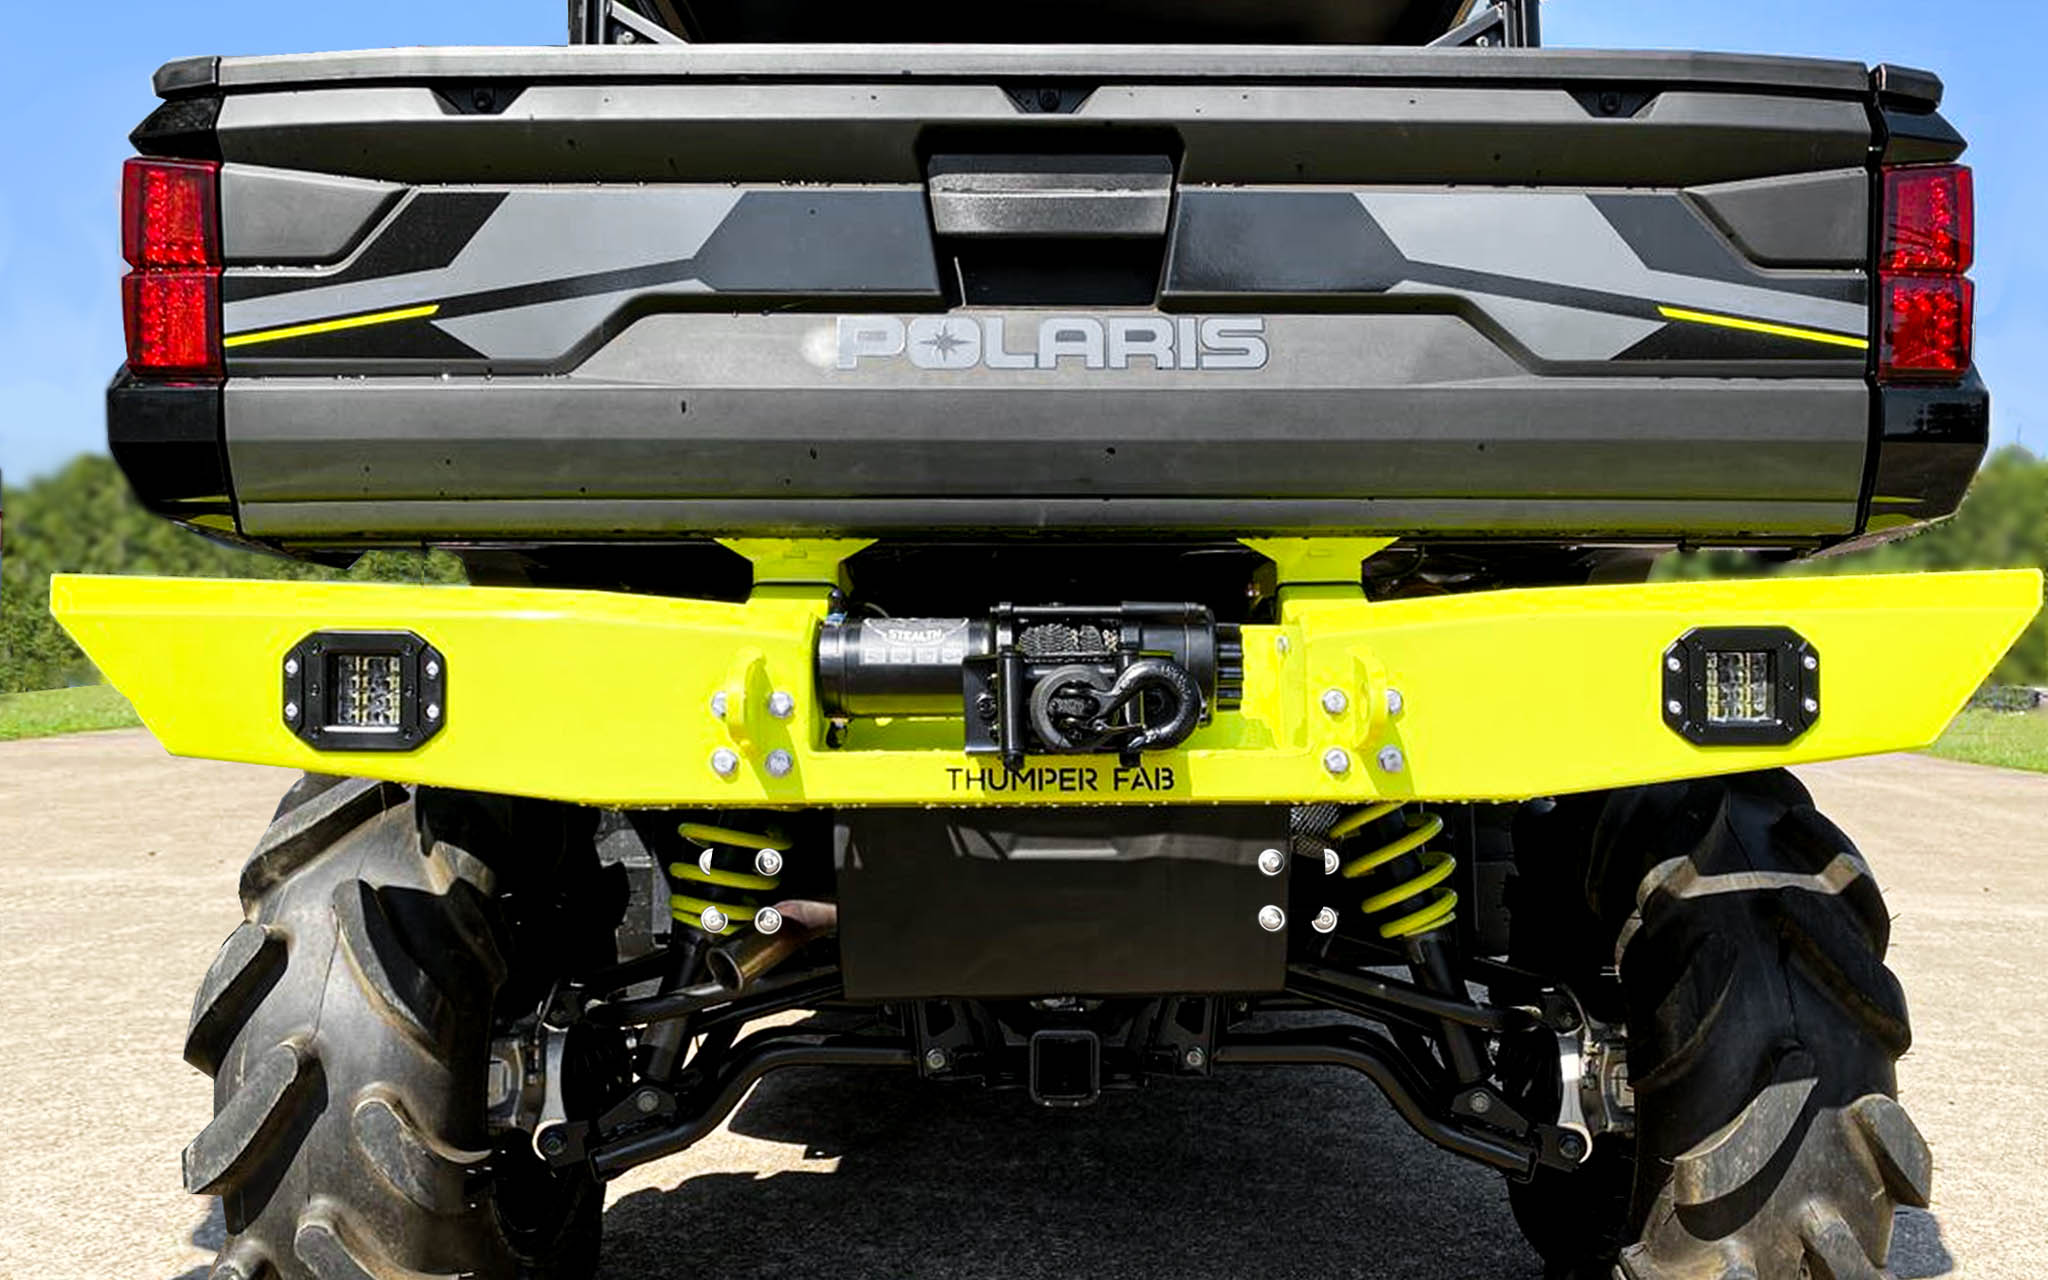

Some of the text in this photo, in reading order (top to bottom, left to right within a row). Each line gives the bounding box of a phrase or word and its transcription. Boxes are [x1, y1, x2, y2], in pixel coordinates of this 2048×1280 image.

[835, 315, 1269, 371] POLARIS
[945, 767, 1175, 792] THUMPER FAB
